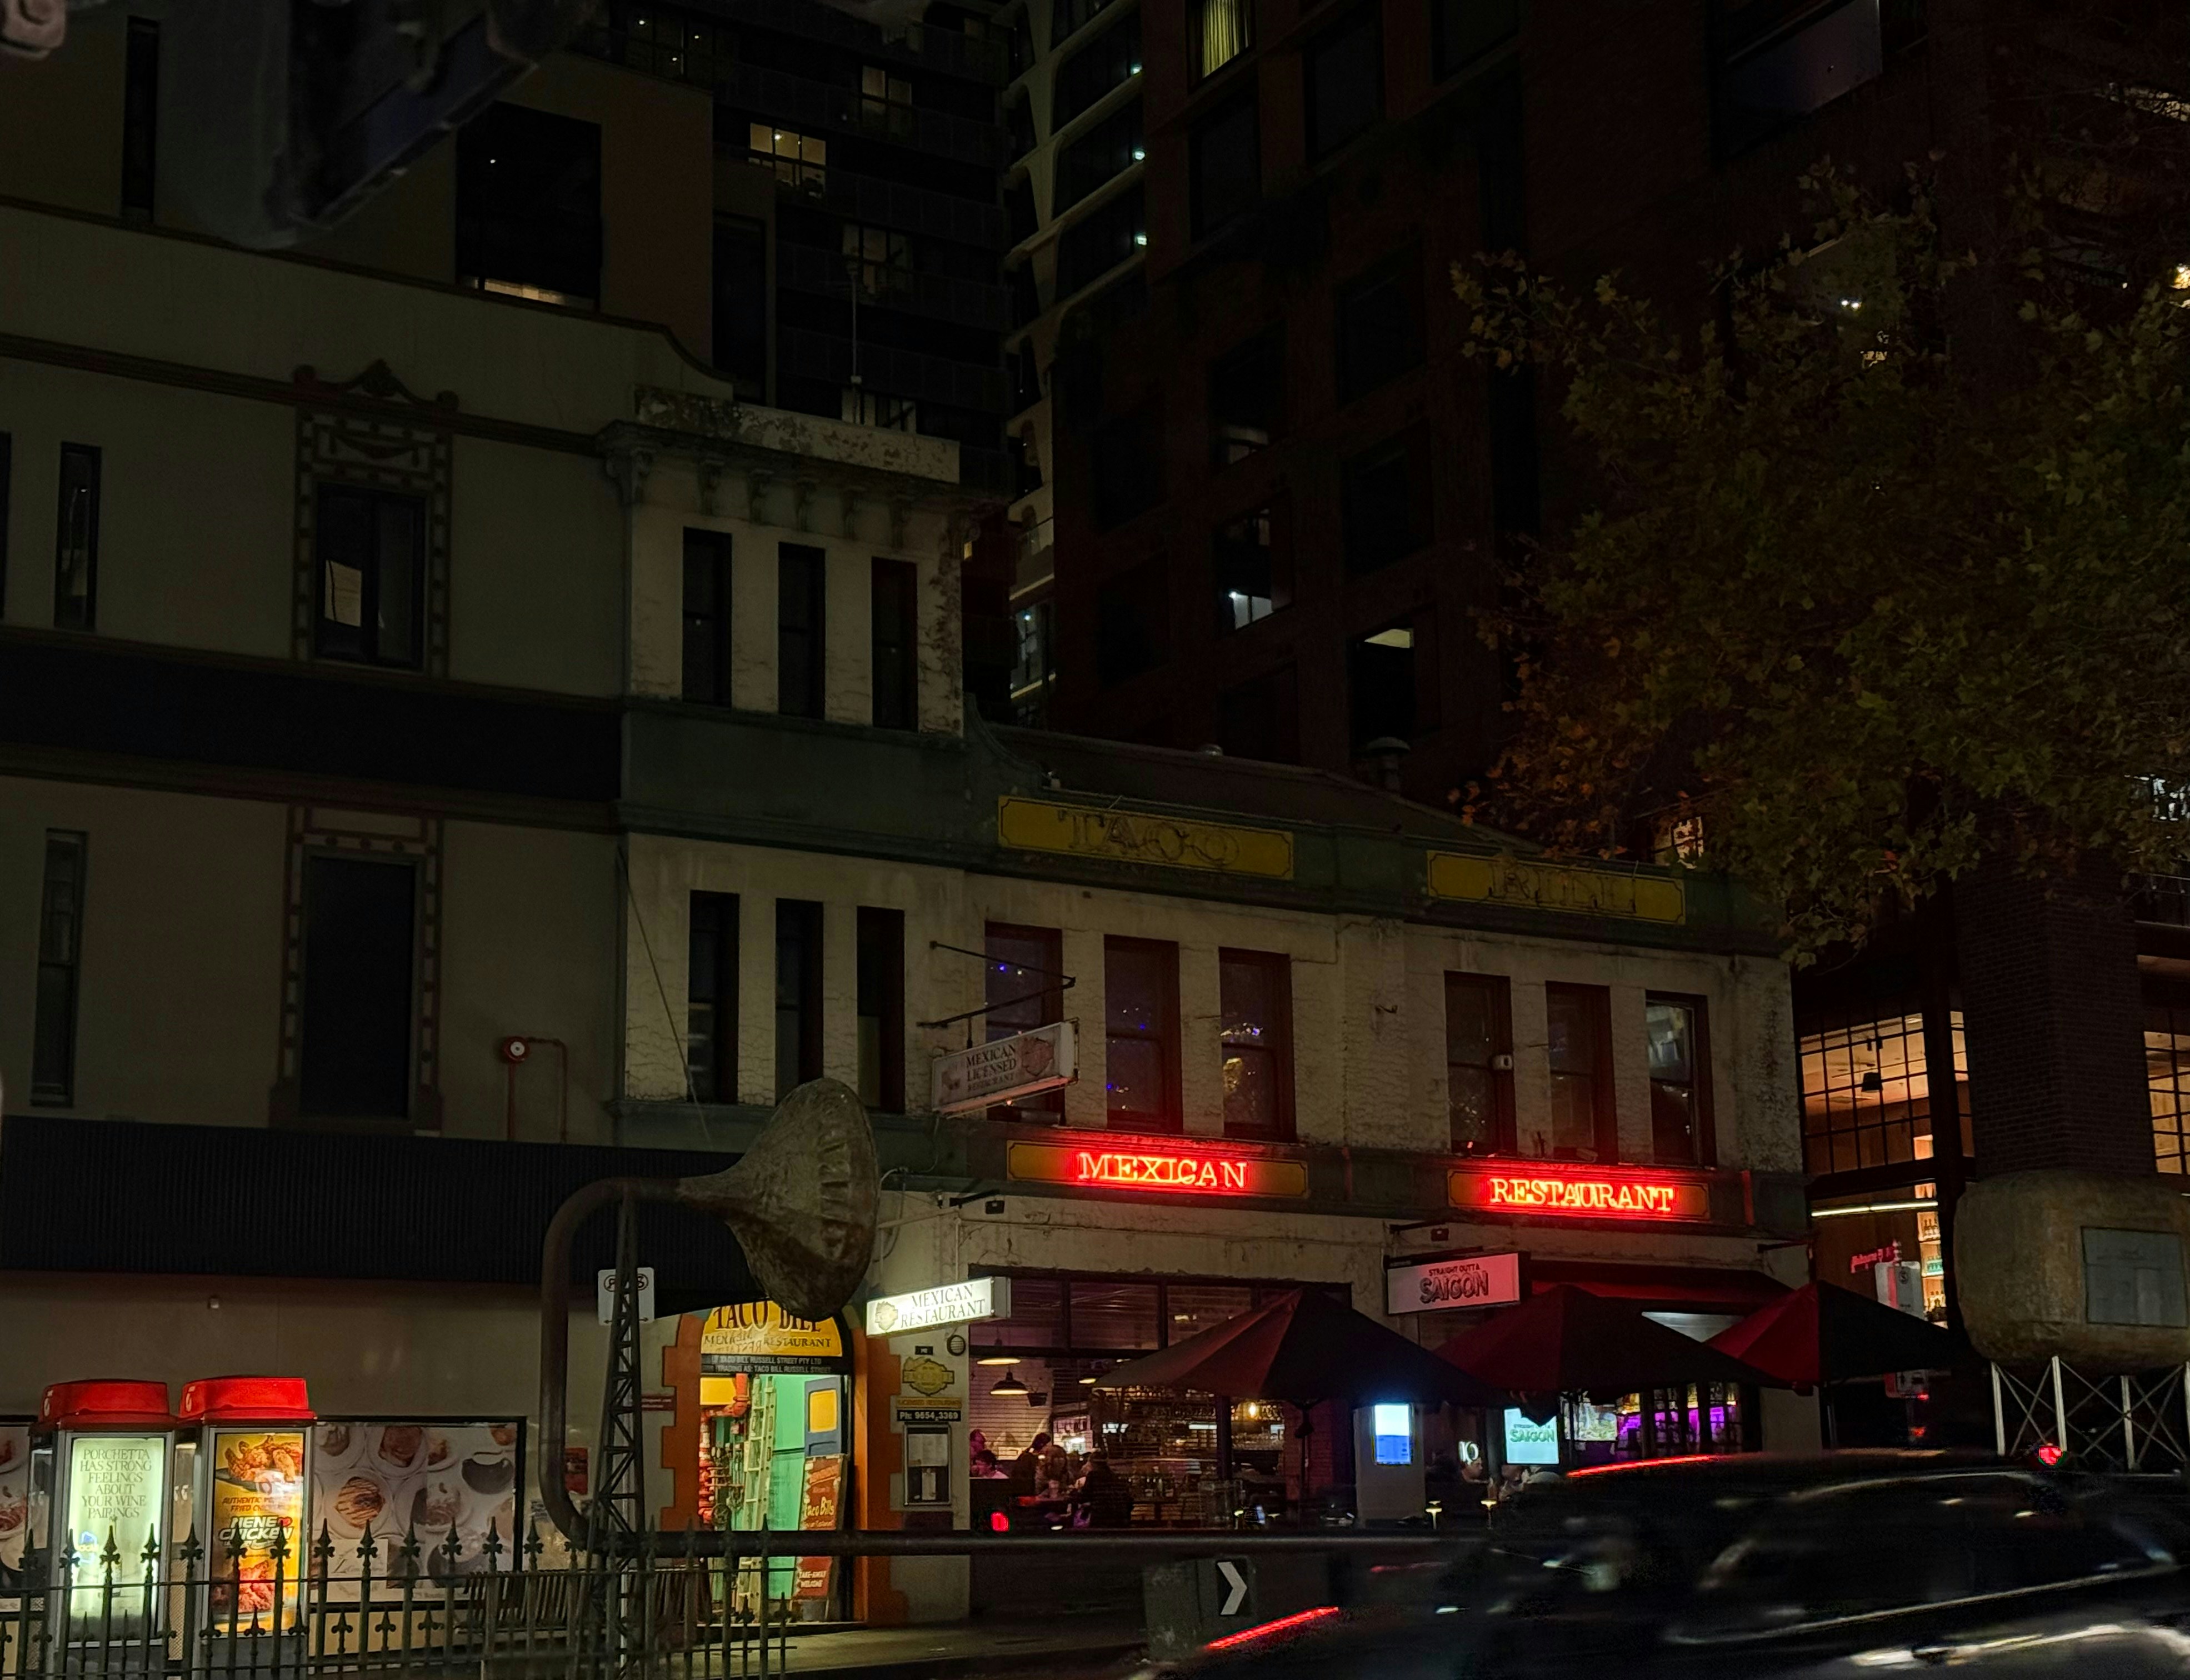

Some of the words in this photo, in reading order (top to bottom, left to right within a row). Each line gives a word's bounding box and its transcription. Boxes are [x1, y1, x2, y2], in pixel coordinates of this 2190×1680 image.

[967, 1044, 1016, 1067] MEXICAN
[967, 1058, 1016, 1081] LICENSED
[1077, 1151, 1248, 1188] MEXICAN
[1489, 1178, 1674, 1212] RESTAURANT
[1459, 1263, 1480, 1273] OUTTA
[1419, 1270, 1488, 1304] SAIGON
[911, 1284, 973, 1308] MEXICAN
[713, 1301, 768, 1329] TACO
[901, 1299, 986, 1328] RESTAURANT
[764, 1336, 831, 1347] RESTAURANT
[1510, 1429, 1554, 1442] SAIGON
[83, 1449, 150, 1459] PORCHETTA
[80, 1461, 103, 1472] HAS
[106, 1461, 152, 1472] STRONG
[88, 1472, 143, 1483] FEELINGS
[95, 1483, 135, 1494] ABOUT
[82, 1496, 112, 1507] YOUR
[116, 1496, 147, 1507] WINE
[88, 1507, 140, 1518] PAIRINGS
[231, 1516, 278, 1528] NENE
